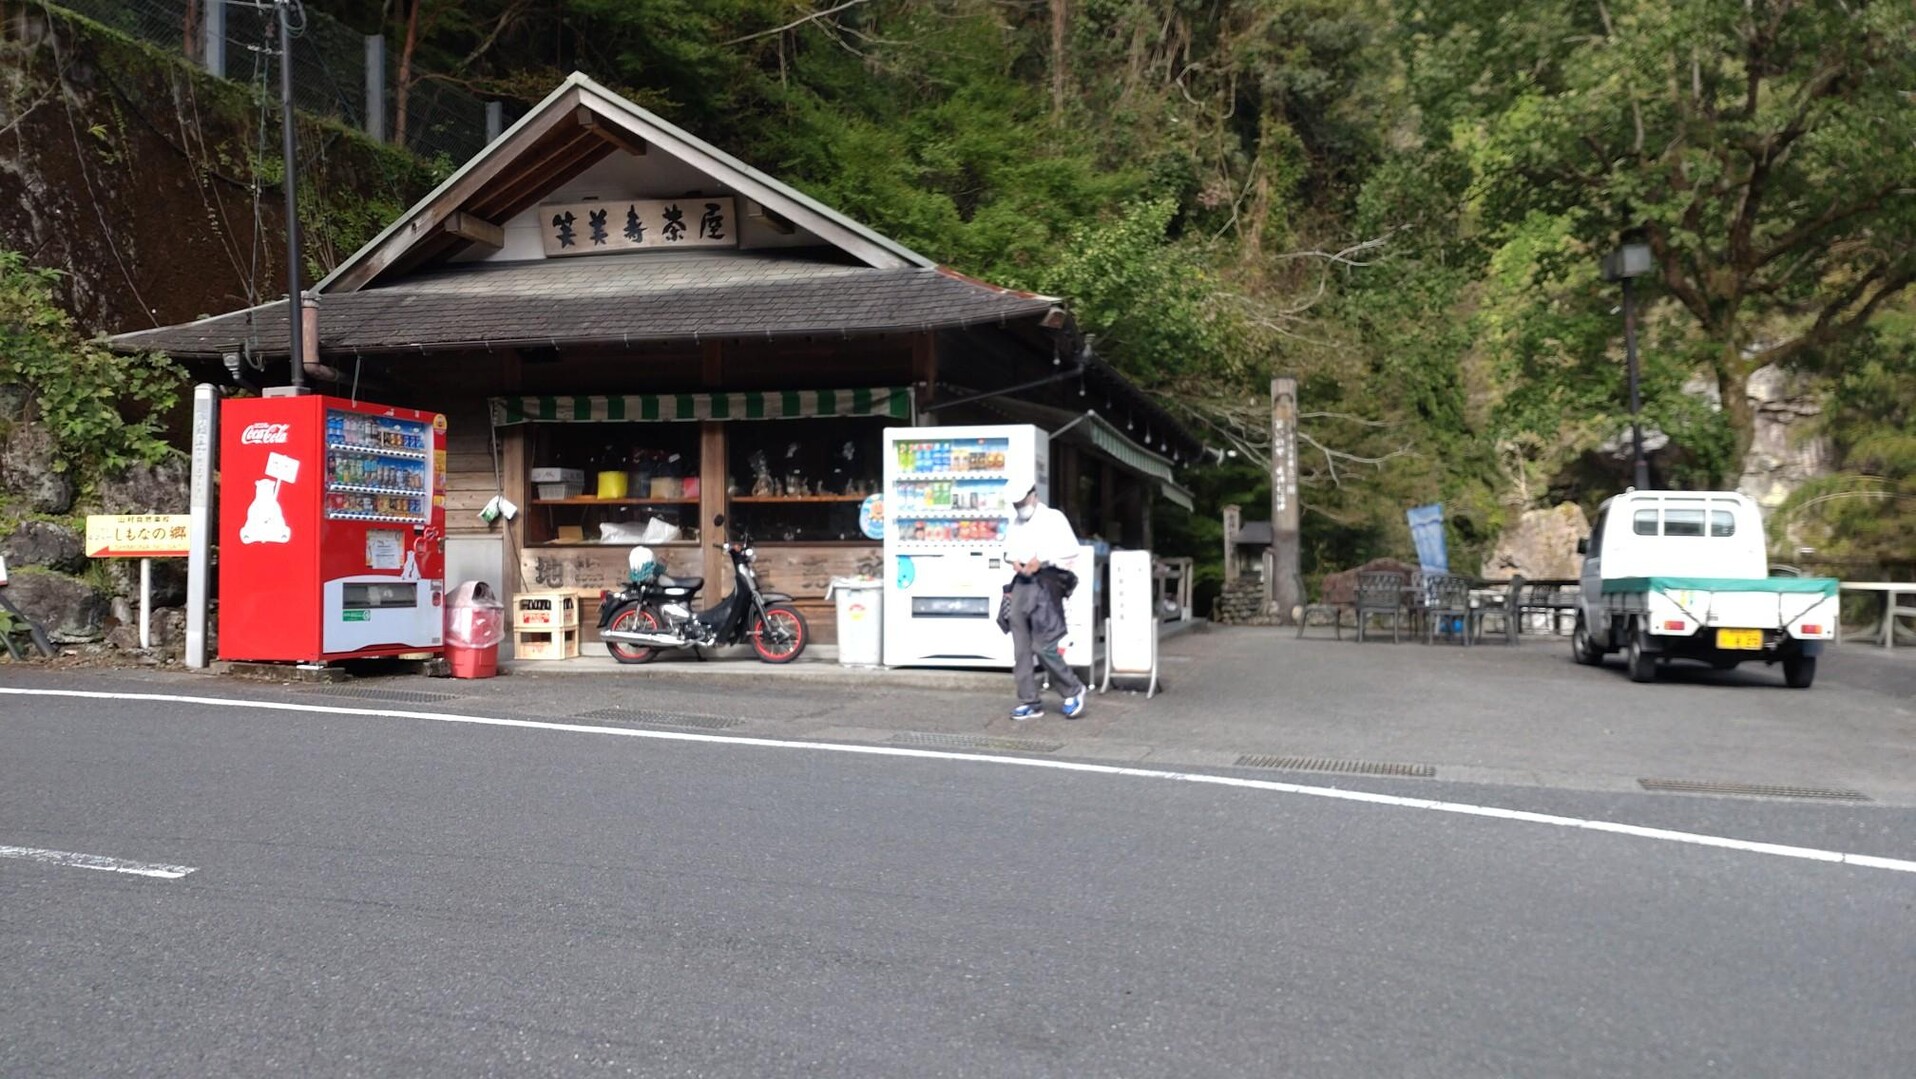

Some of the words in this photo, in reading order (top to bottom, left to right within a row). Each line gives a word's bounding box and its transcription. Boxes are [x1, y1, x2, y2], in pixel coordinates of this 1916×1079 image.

[115, 526, 187, 541] しもなの郷
